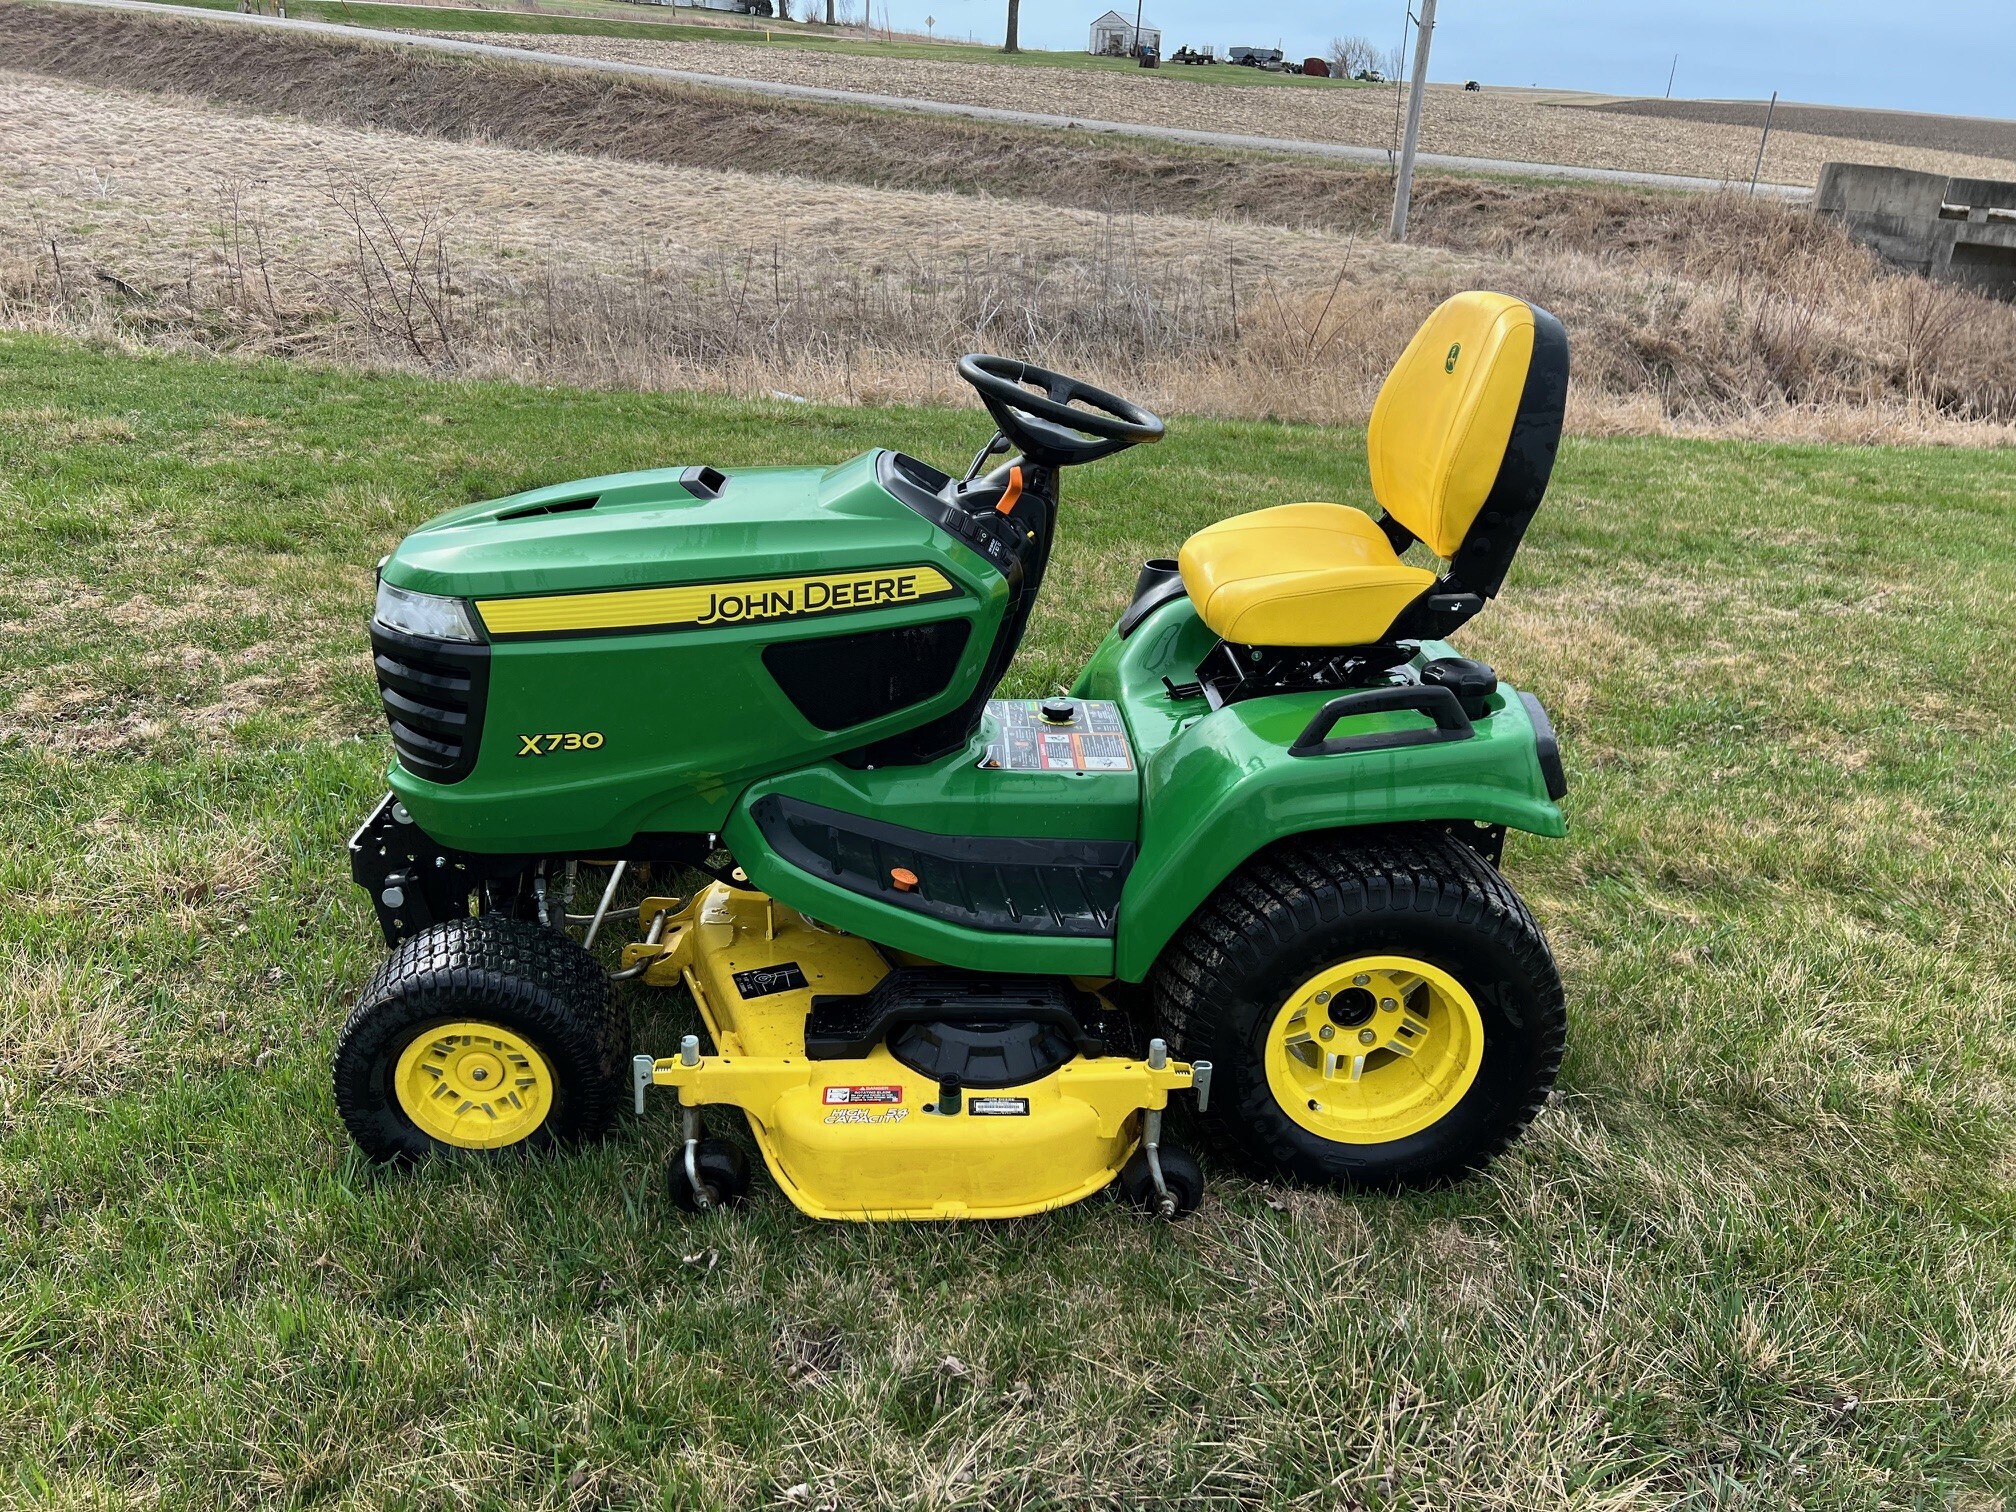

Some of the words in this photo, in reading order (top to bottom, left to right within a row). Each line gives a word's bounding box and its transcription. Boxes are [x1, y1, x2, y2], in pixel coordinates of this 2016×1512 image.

[697, 590, 795, 623] JOHN
[803, 574, 918, 611] DEERE
[516, 731, 606, 756] X730
[824, 1115, 905, 1124] CAPACITY
[831, 1108, 869, 1117] HIGH
[886, 1108, 909, 1117] 54
